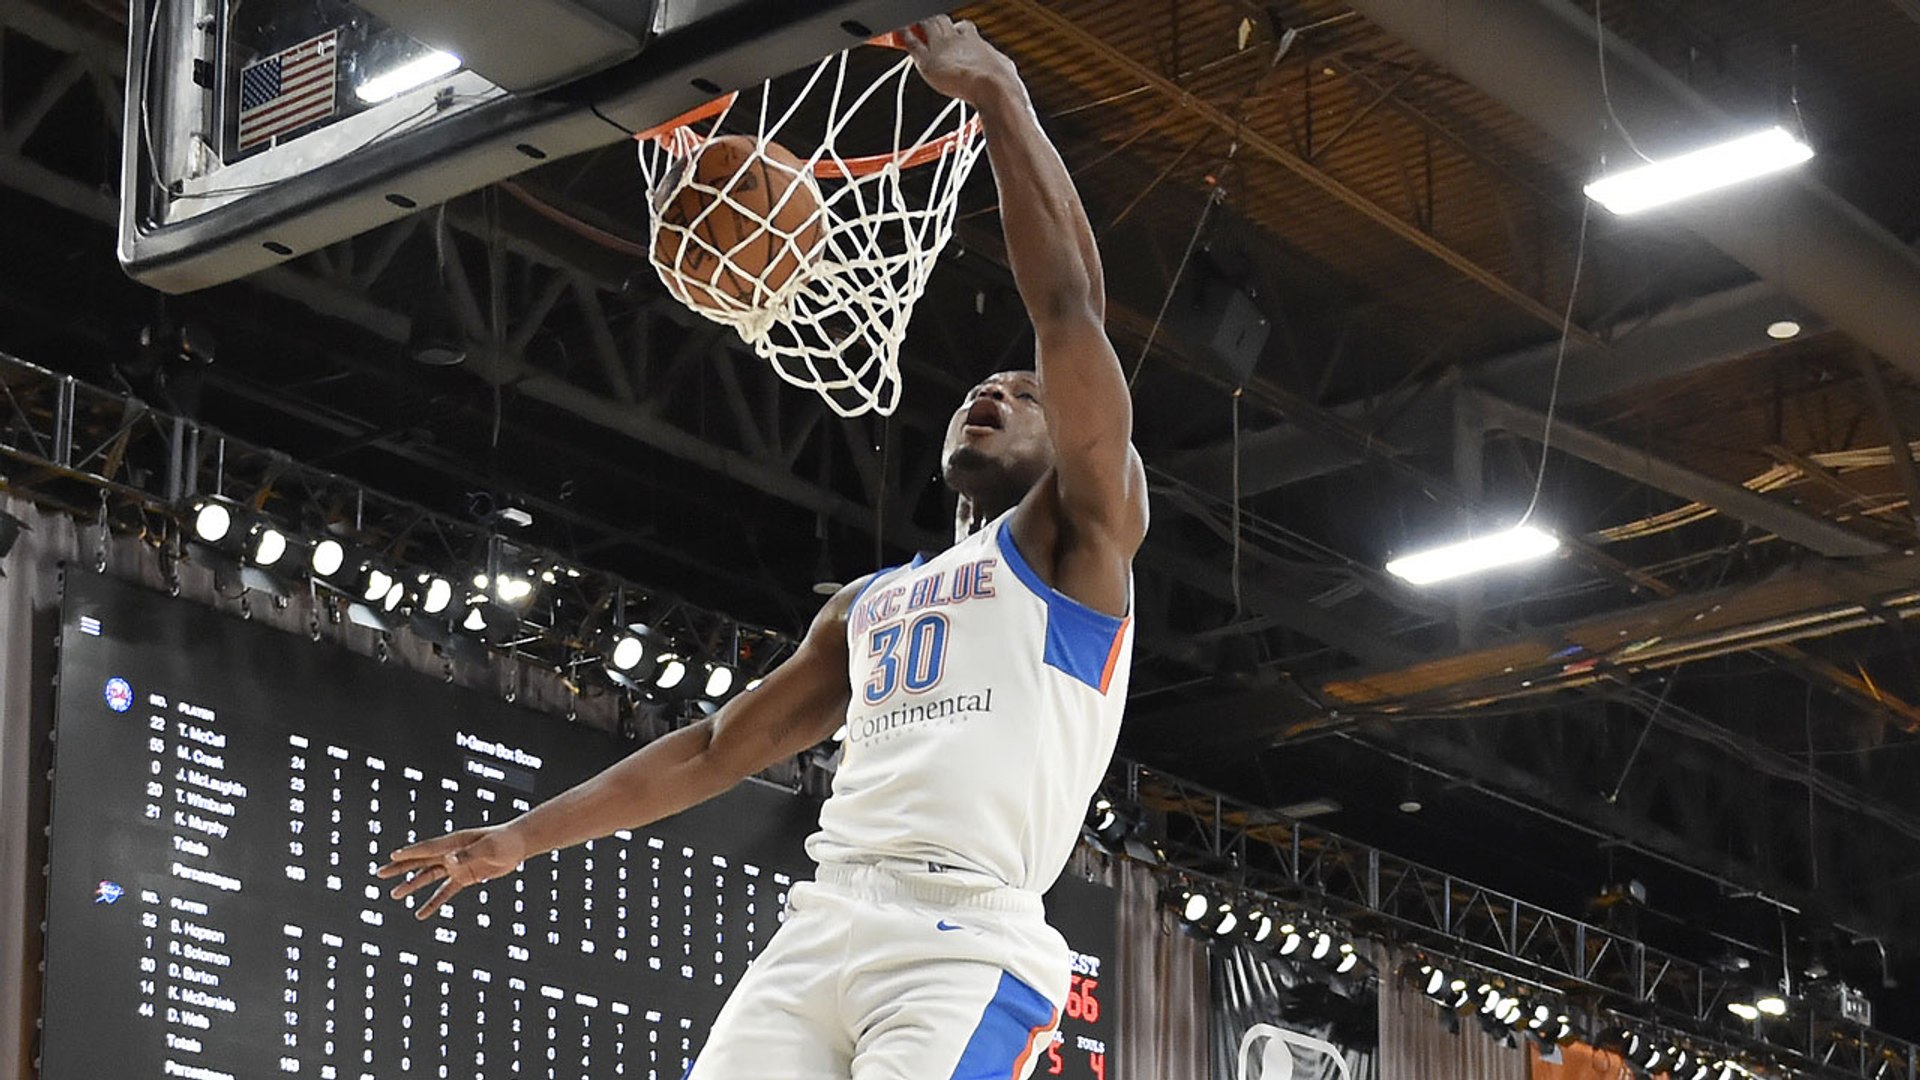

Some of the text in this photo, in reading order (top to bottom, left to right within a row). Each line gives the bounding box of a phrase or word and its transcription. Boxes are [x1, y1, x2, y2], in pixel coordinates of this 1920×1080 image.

[905, 559, 997, 614] BLUE
[863, 611, 951, 707] 30
[849, 687, 992, 743] Continental
[149, 715, 166, 731] 22
[177, 722, 188, 738] T.
[151, 760, 162, 774] 0
[290, 755, 306, 770] 24
[175, 767, 187, 782] J.
[333, 767, 341, 780] 1
[146, 781, 163, 797] 20
[175, 788, 186, 803] T.
[409, 789, 416, 801] 1
[144, 803, 161, 818] 21
[445, 799, 454, 812] 2
[331, 809, 341, 822] 3
[408, 809, 416, 822] 1
[482, 809, 489, 821] 1
[174, 810, 230, 839] K. Murphy
[289, 819, 304, 834] 17
[367, 819, 382, 834] 15
[444, 819, 453, 832] 3
[330, 830, 340, 844] 2
[407, 829, 417, 842] 2
[289, 841, 304, 855] 13
[618, 848, 627, 860] 4
[330, 851, 339, 865] 3
[551, 850, 559, 861] 2
[584, 858, 594, 870] 3
[651, 857, 660, 869] 2
[551, 869, 558, 880] 1
[684, 866, 692, 877] 4
[584, 877, 593, 890] 2
[652, 877, 659, 888] 1
[715, 874, 724, 887] 2
[550, 889, 558, 900] 1
[617, 887, 627, 899] 3
[683, 885, 692, 897] 0
[746, 883, 756, 895] 2
[583, 898, 593, 910] 2
[716, 894, 723, 905] 1
[778, 893, 786, 904] 0
[514, 899, 524, 912] 0
[684, 904, 691, 916] 1
[746, 902, 755, 914] 4
[549, 908, 558, 921] 2
[617, 906, 626, 919] 3
[715, 912, 723, 925] 2
[141, 912, 158, 928] 32
[584, 918, 591, 929] 1
[650, 915, 659, 927] 2
[746, 921, 755, 932] 4
[184, 922, 226, 945] Hopson
[617, 926, 626, 938] 3
[683, 923, 691, 935] 2
[145, 935, 153, 949] 1
[547, 931, 560, 944] 11
[650, 934, 659, 947] 0
[715, 932, 722, 943] 1
[683, 943, 690, 954] 1
[747, 940, 754, 951] 1
[169, 941, 231, 967] R. Solomon
[714, 950, 723, 963] 0
[140, 956, 156, 972] 30
[327, 955, 337, 969] 2
[1069, 949, 1101, 978] EST
[168, 962, 220, 987] D. Burton
[285, 967, 299, 982] 14
[403, 973, 413, 986] 0
[139, 979, 155, 995] 14
[326, 977, 336, 989] 4
[167, 985, 237, 1013] K. McDaniels
[283, 988, 297, 1003] 21
[404, 994, 411, 1007] 1
[478, 991, 485, 1003] 1
[1066, 974, 1099, 1023] 66
[137, 1002, 154, 1017] 44
[325, 998, 335, 1011] 4
[440, 1002, 449, 1016] 2
[513, 999, 520, 1011] 1
[166, 1008, 180, 1023] D.
[283, 1010, 298, 1025] 12
[476, 1010, 485, 1024] 2
[547, 1006, 556, 1019] 0
[325, 1019, 335, 1033] 2
[402, 1015, 412, 1028] 0
[512, 1018, 521, 1031] 2
[583, 1015, 589, 1027] 1
[364, 1027, 373, 1041] 3
[439, 1023, 449, 1036] 3
[616, 1023, 624, 1034] 1
[283, 1032, 297, 1046] 14
[403, 1036, 410, 1049] 1
[477, 1031, 484, 1043] 1
[581, 1034, 590, 1047] 2
[649, 1030, 658, 1042] 0
[324, 1040, 334, 1055] 0
[440, 1044, 447, 1056] 1
[512, 1039, 520, 1051] 1
[616, 1042, 624, 1054] 7
[681, 1037, 690, 1050] 2
[475, 1051, 485, 1065] 3
[546, 1047, 556, 1060] 0
[649, 1050, 656, 1062] 1
[401, 1057, 411, 1070] 0
[511, 1060, 520, 1072] 4
[581, 1055, 590, 1066] 4
[1048, 1041, 1106, 1080] 5 4
[438, 1064, 448, 1078] 0
[547, 1067, 555, 1079] 1
[615, 1062, 624, 1074] 4
